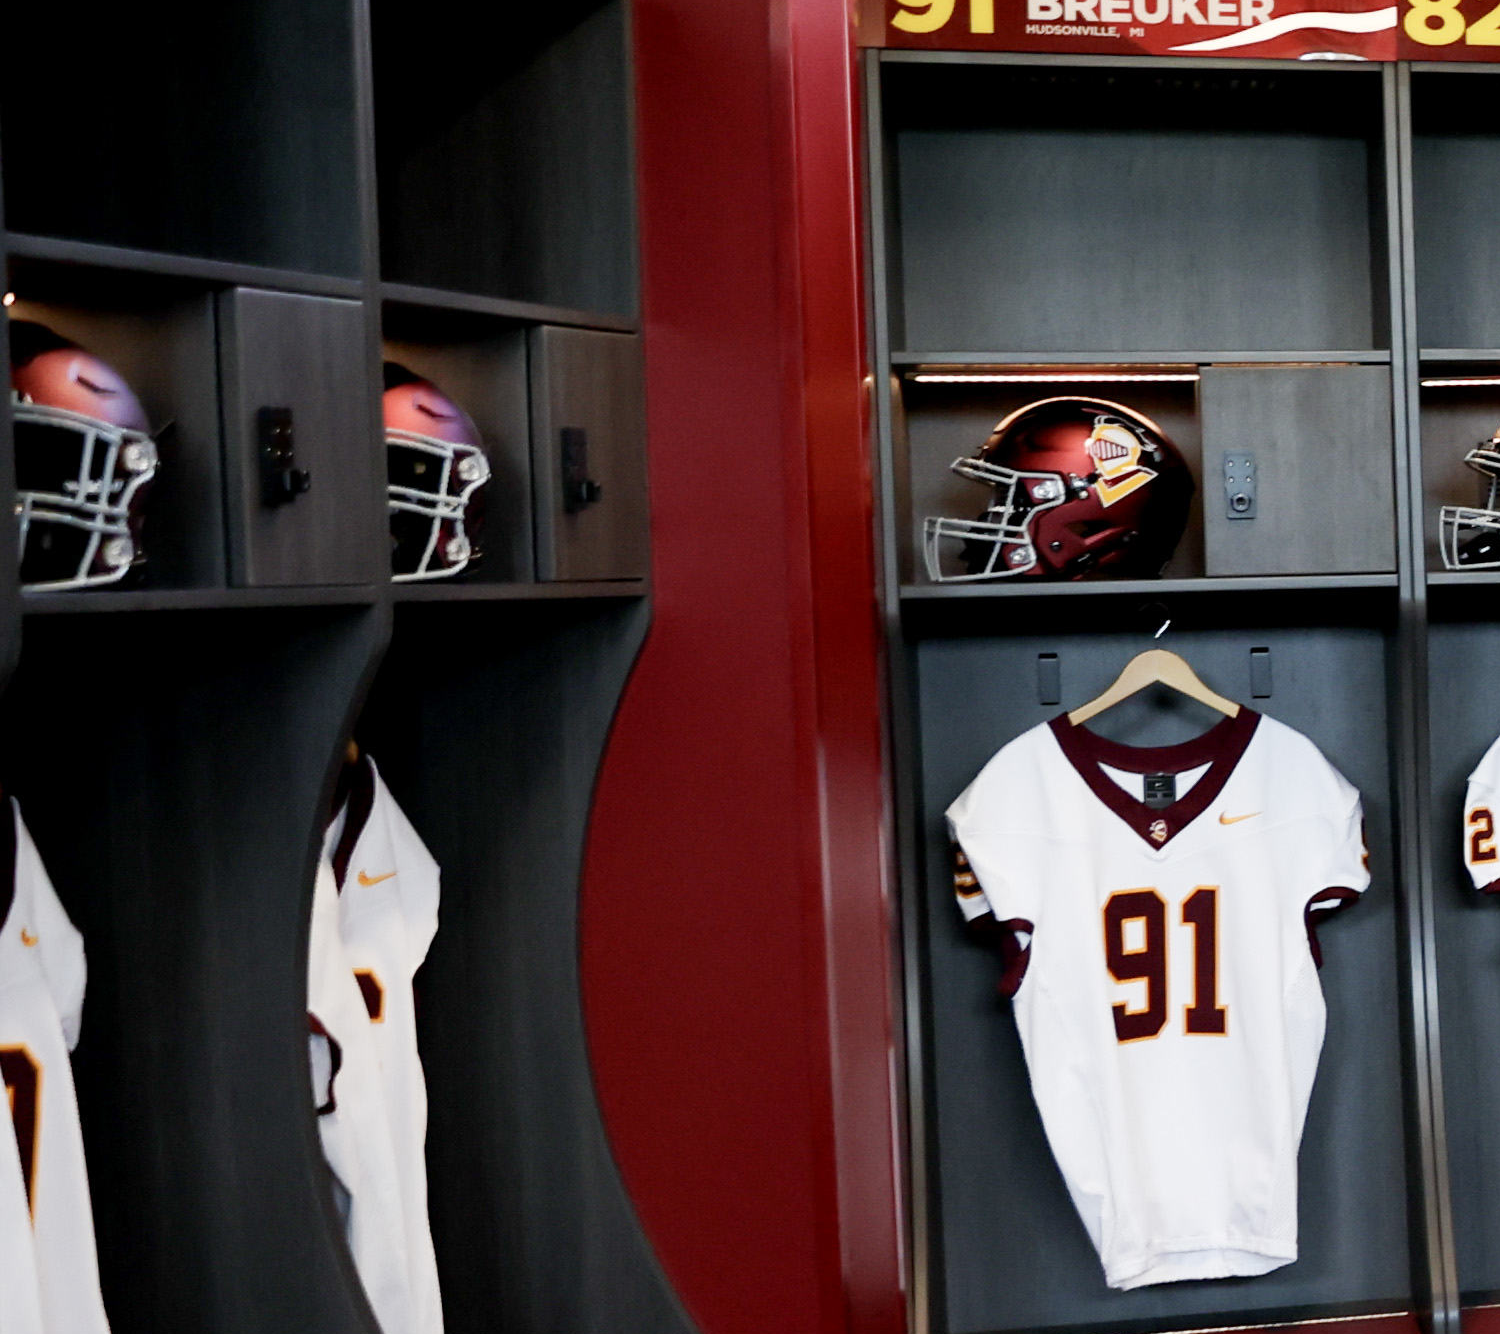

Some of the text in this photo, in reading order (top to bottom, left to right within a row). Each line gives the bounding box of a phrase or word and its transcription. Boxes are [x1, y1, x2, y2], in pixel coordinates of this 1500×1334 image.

[1026, 24, 1145, 39] HUDSONVILLE, MI
[1467, 806, 1498, 865] 2
[1101, 885, 1229, 1046] 91
